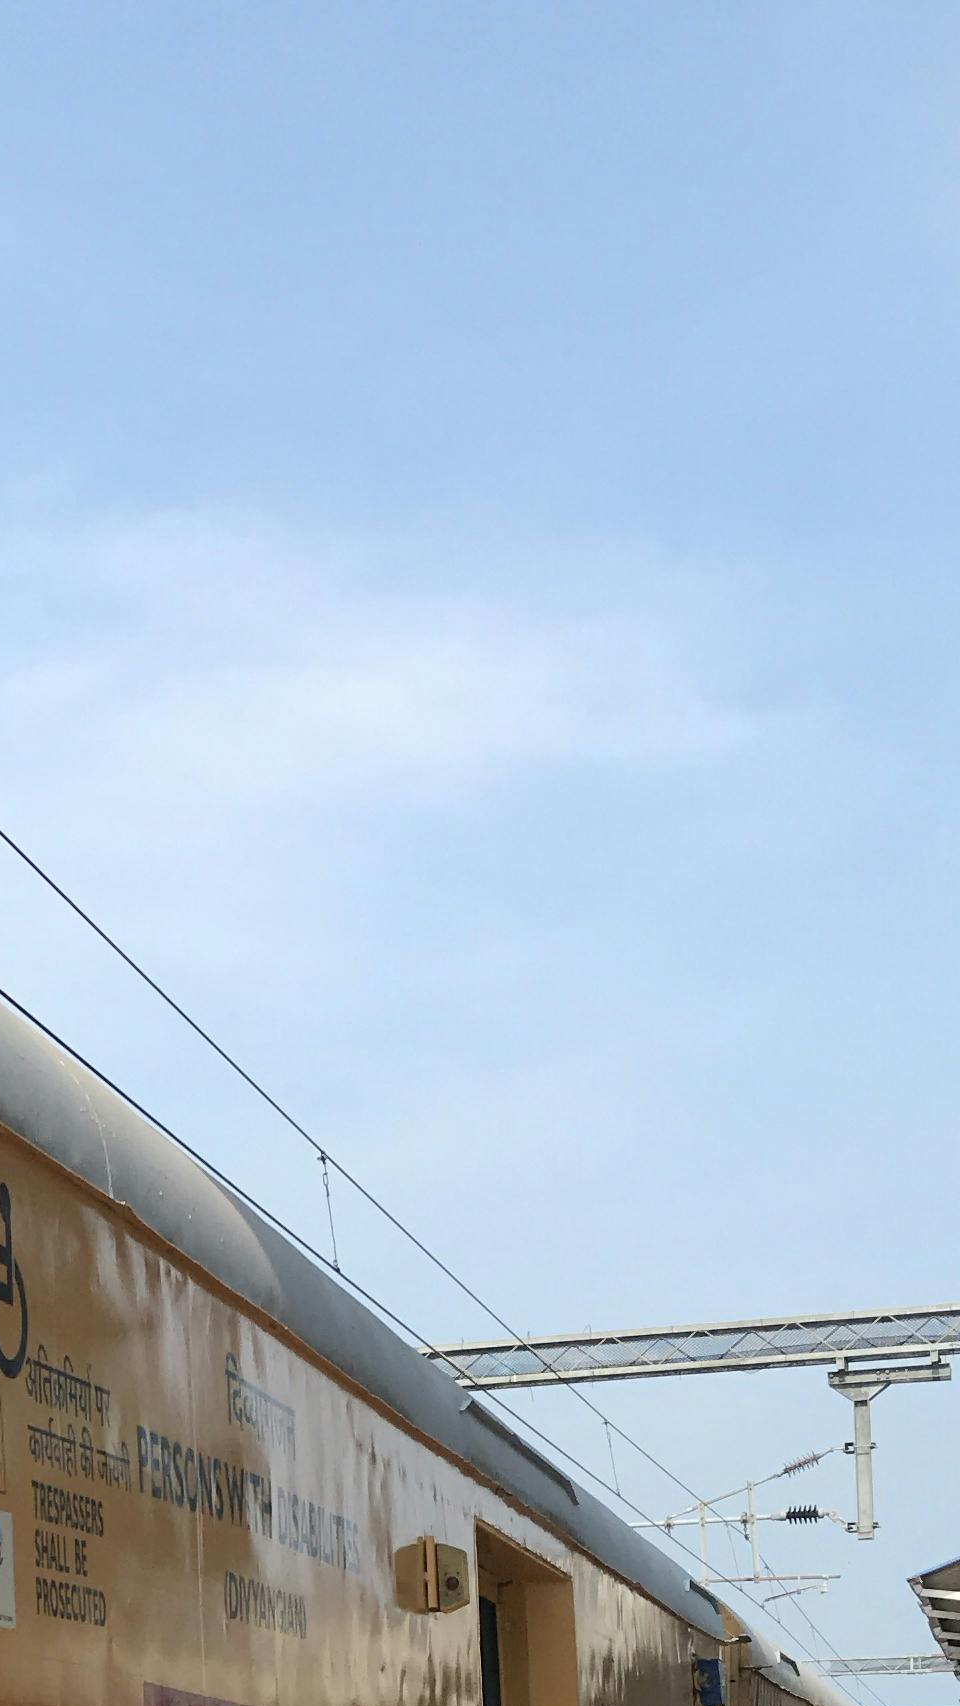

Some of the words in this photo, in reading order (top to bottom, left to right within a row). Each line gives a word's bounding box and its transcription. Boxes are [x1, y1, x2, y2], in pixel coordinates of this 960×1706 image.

[95, 1384, 111, 1428] पर
[79, 1427, 94, 1481] की
[136, 1425, 224, 1520] PERSONS
[224, 1462, 272, 1539] WITH
[31, 1480, 104, 1537] TRESPASSERS
[35, 1529, 70, 1573] SHALL
[75, 1538, 88, 1577] BE
[36, 1576, 107, 1627] PROSECUTED
